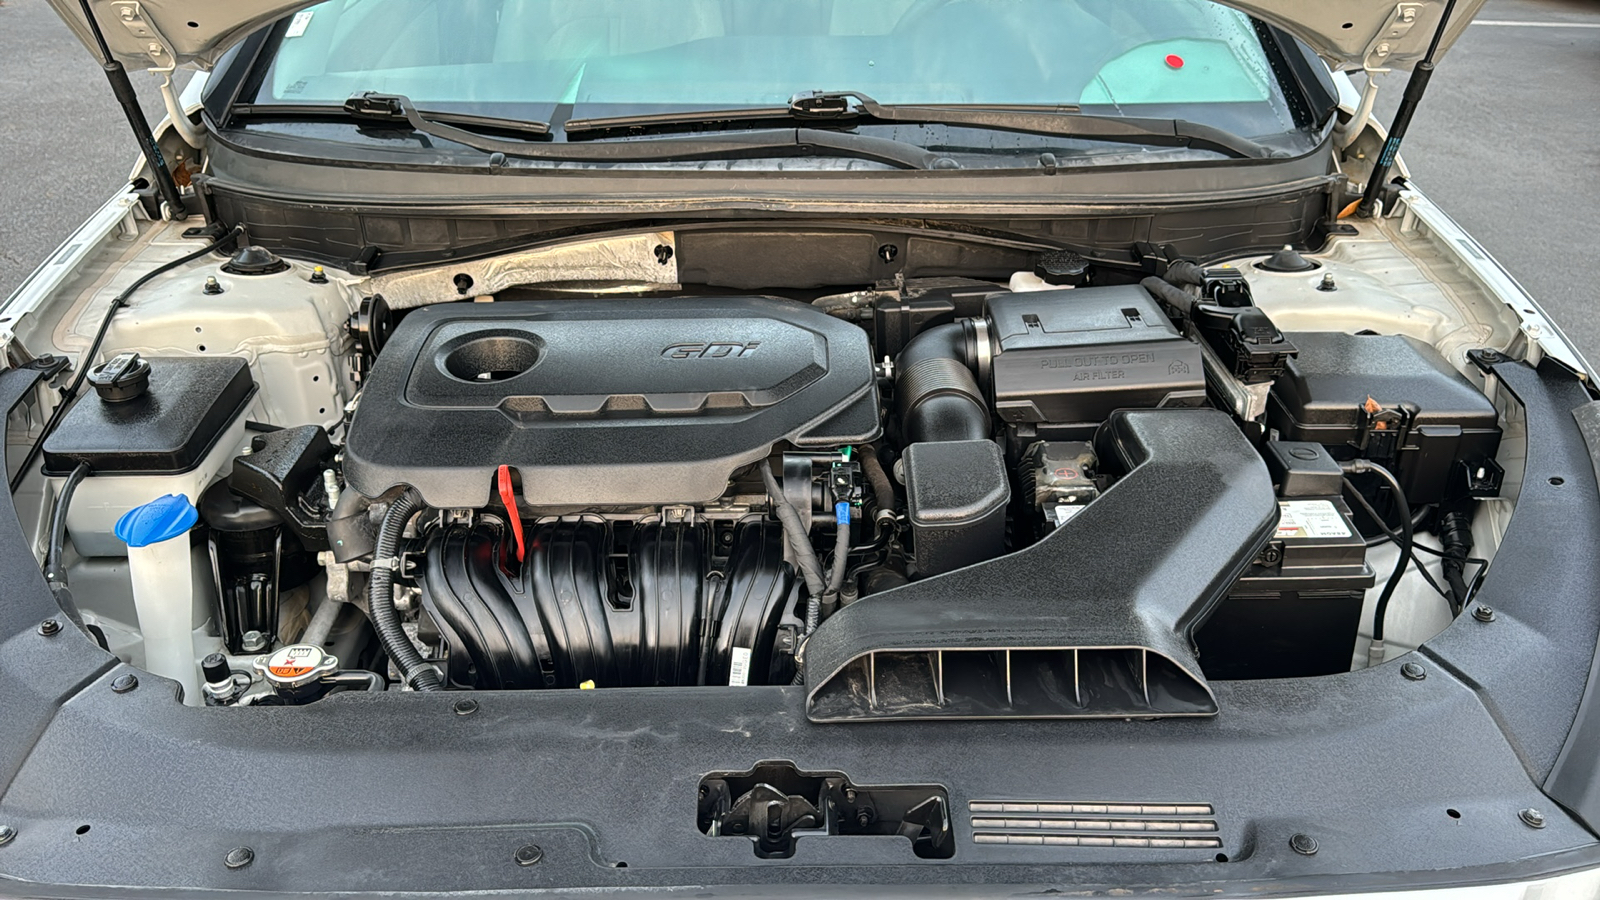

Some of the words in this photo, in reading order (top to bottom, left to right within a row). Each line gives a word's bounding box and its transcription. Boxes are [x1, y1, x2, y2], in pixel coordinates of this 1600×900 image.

[1040, 358, 1072, 369] PULL
[1074, 356, 1099, 367] OUT
[1102, 355, 1119, 366] TO
[1121, 353, 1155, 365] OPEN
[1073, 371, 1090, 382] AIR
[1092, 370, 1125, 380] FILTER
